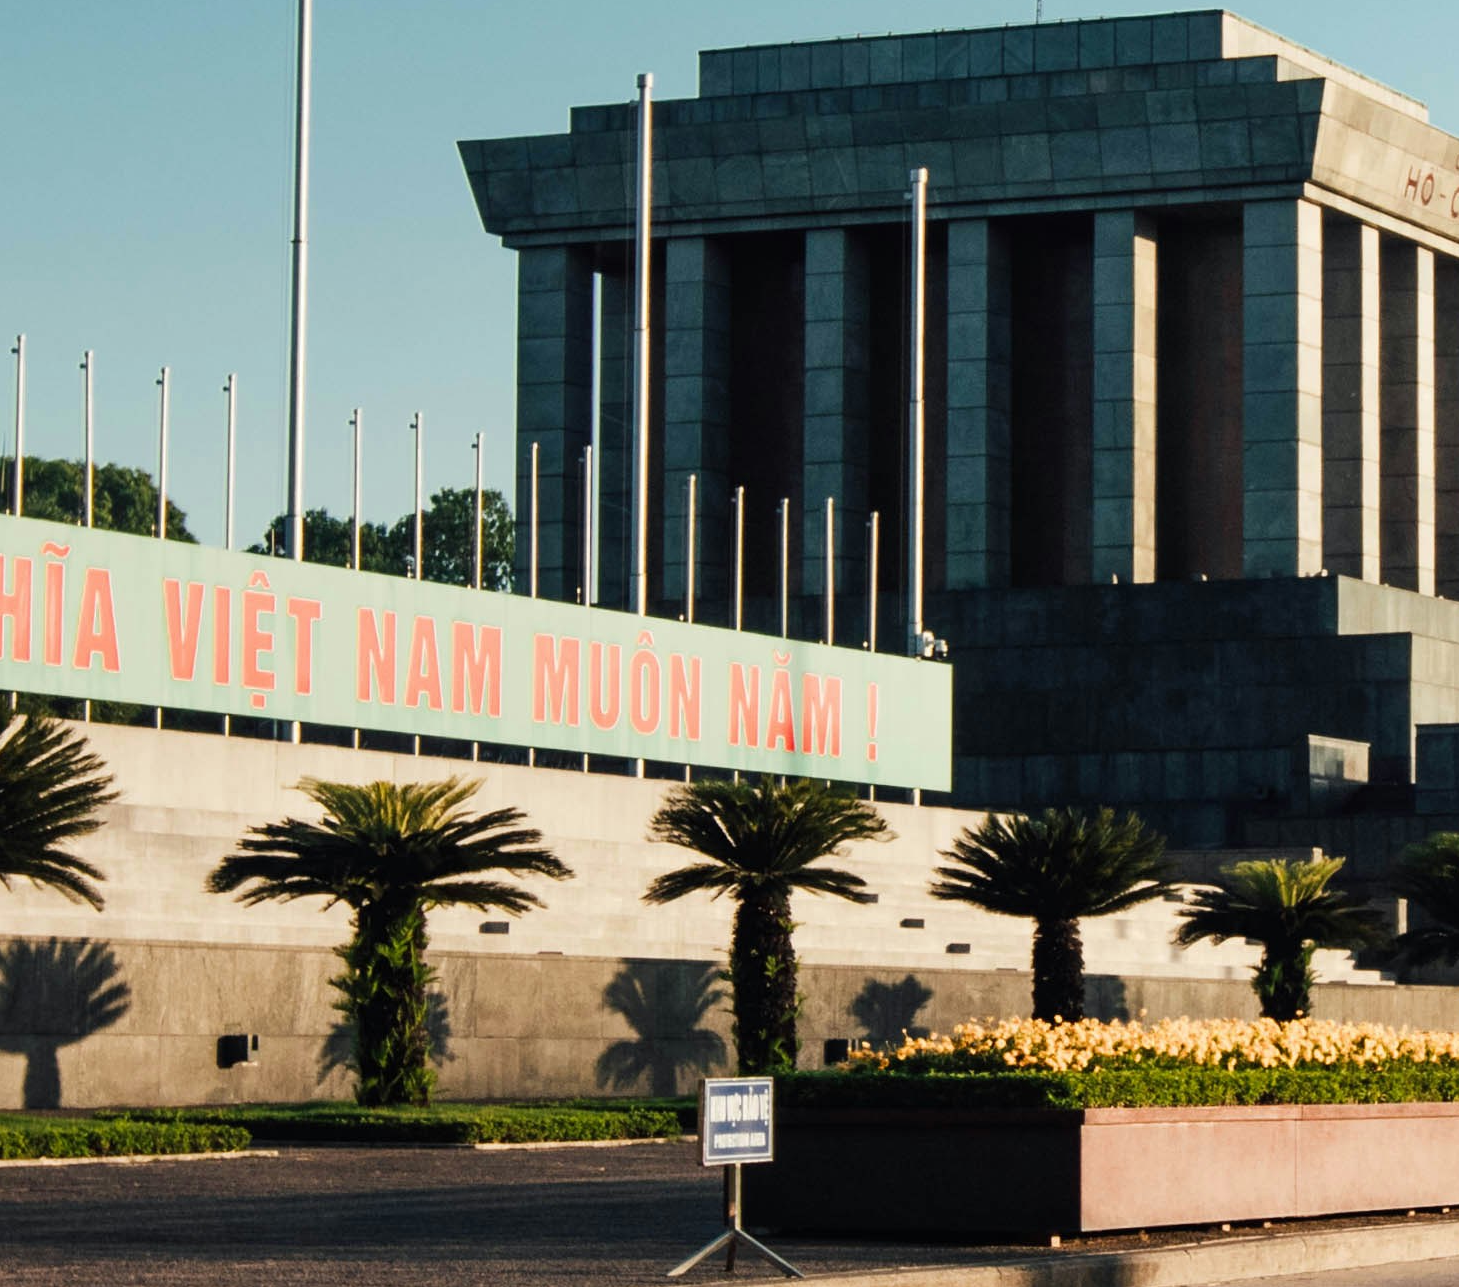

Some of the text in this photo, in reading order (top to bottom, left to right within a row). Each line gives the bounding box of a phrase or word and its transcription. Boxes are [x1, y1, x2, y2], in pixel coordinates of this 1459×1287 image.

[163, 569, 323, 710] VIỆT
[356, 605, 503, 718] NAM
[532, 630, 702, 742] MUÔN
[727, 649, 843, 759] NĂM
